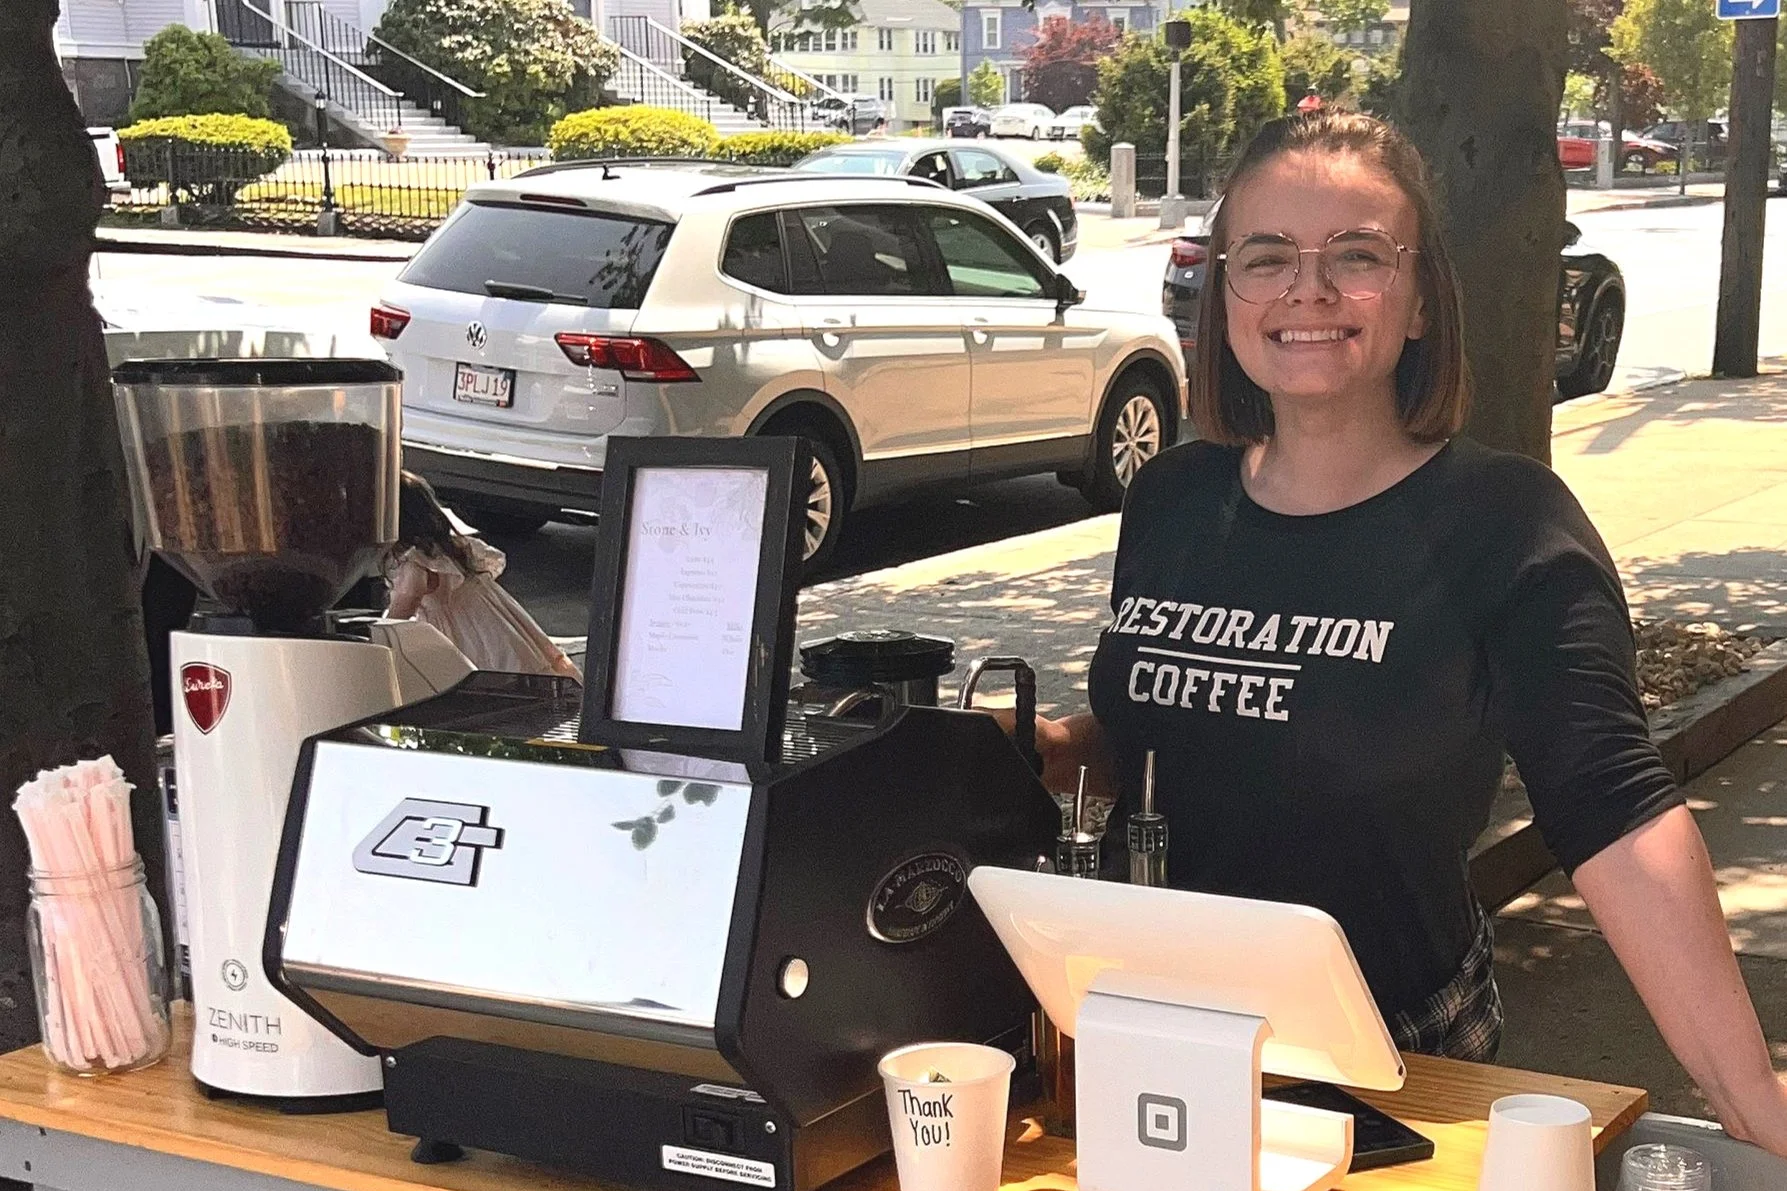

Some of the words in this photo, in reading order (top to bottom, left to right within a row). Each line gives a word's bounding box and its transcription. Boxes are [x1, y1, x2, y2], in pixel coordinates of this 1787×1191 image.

[1107, 596, 1394, 663] RESTORATION
[1128, 660, 1294, 721] COFFEE
[208, 1007, 281, 1035] ZENITH
[242, 1040, 279, 1053] SPEED
